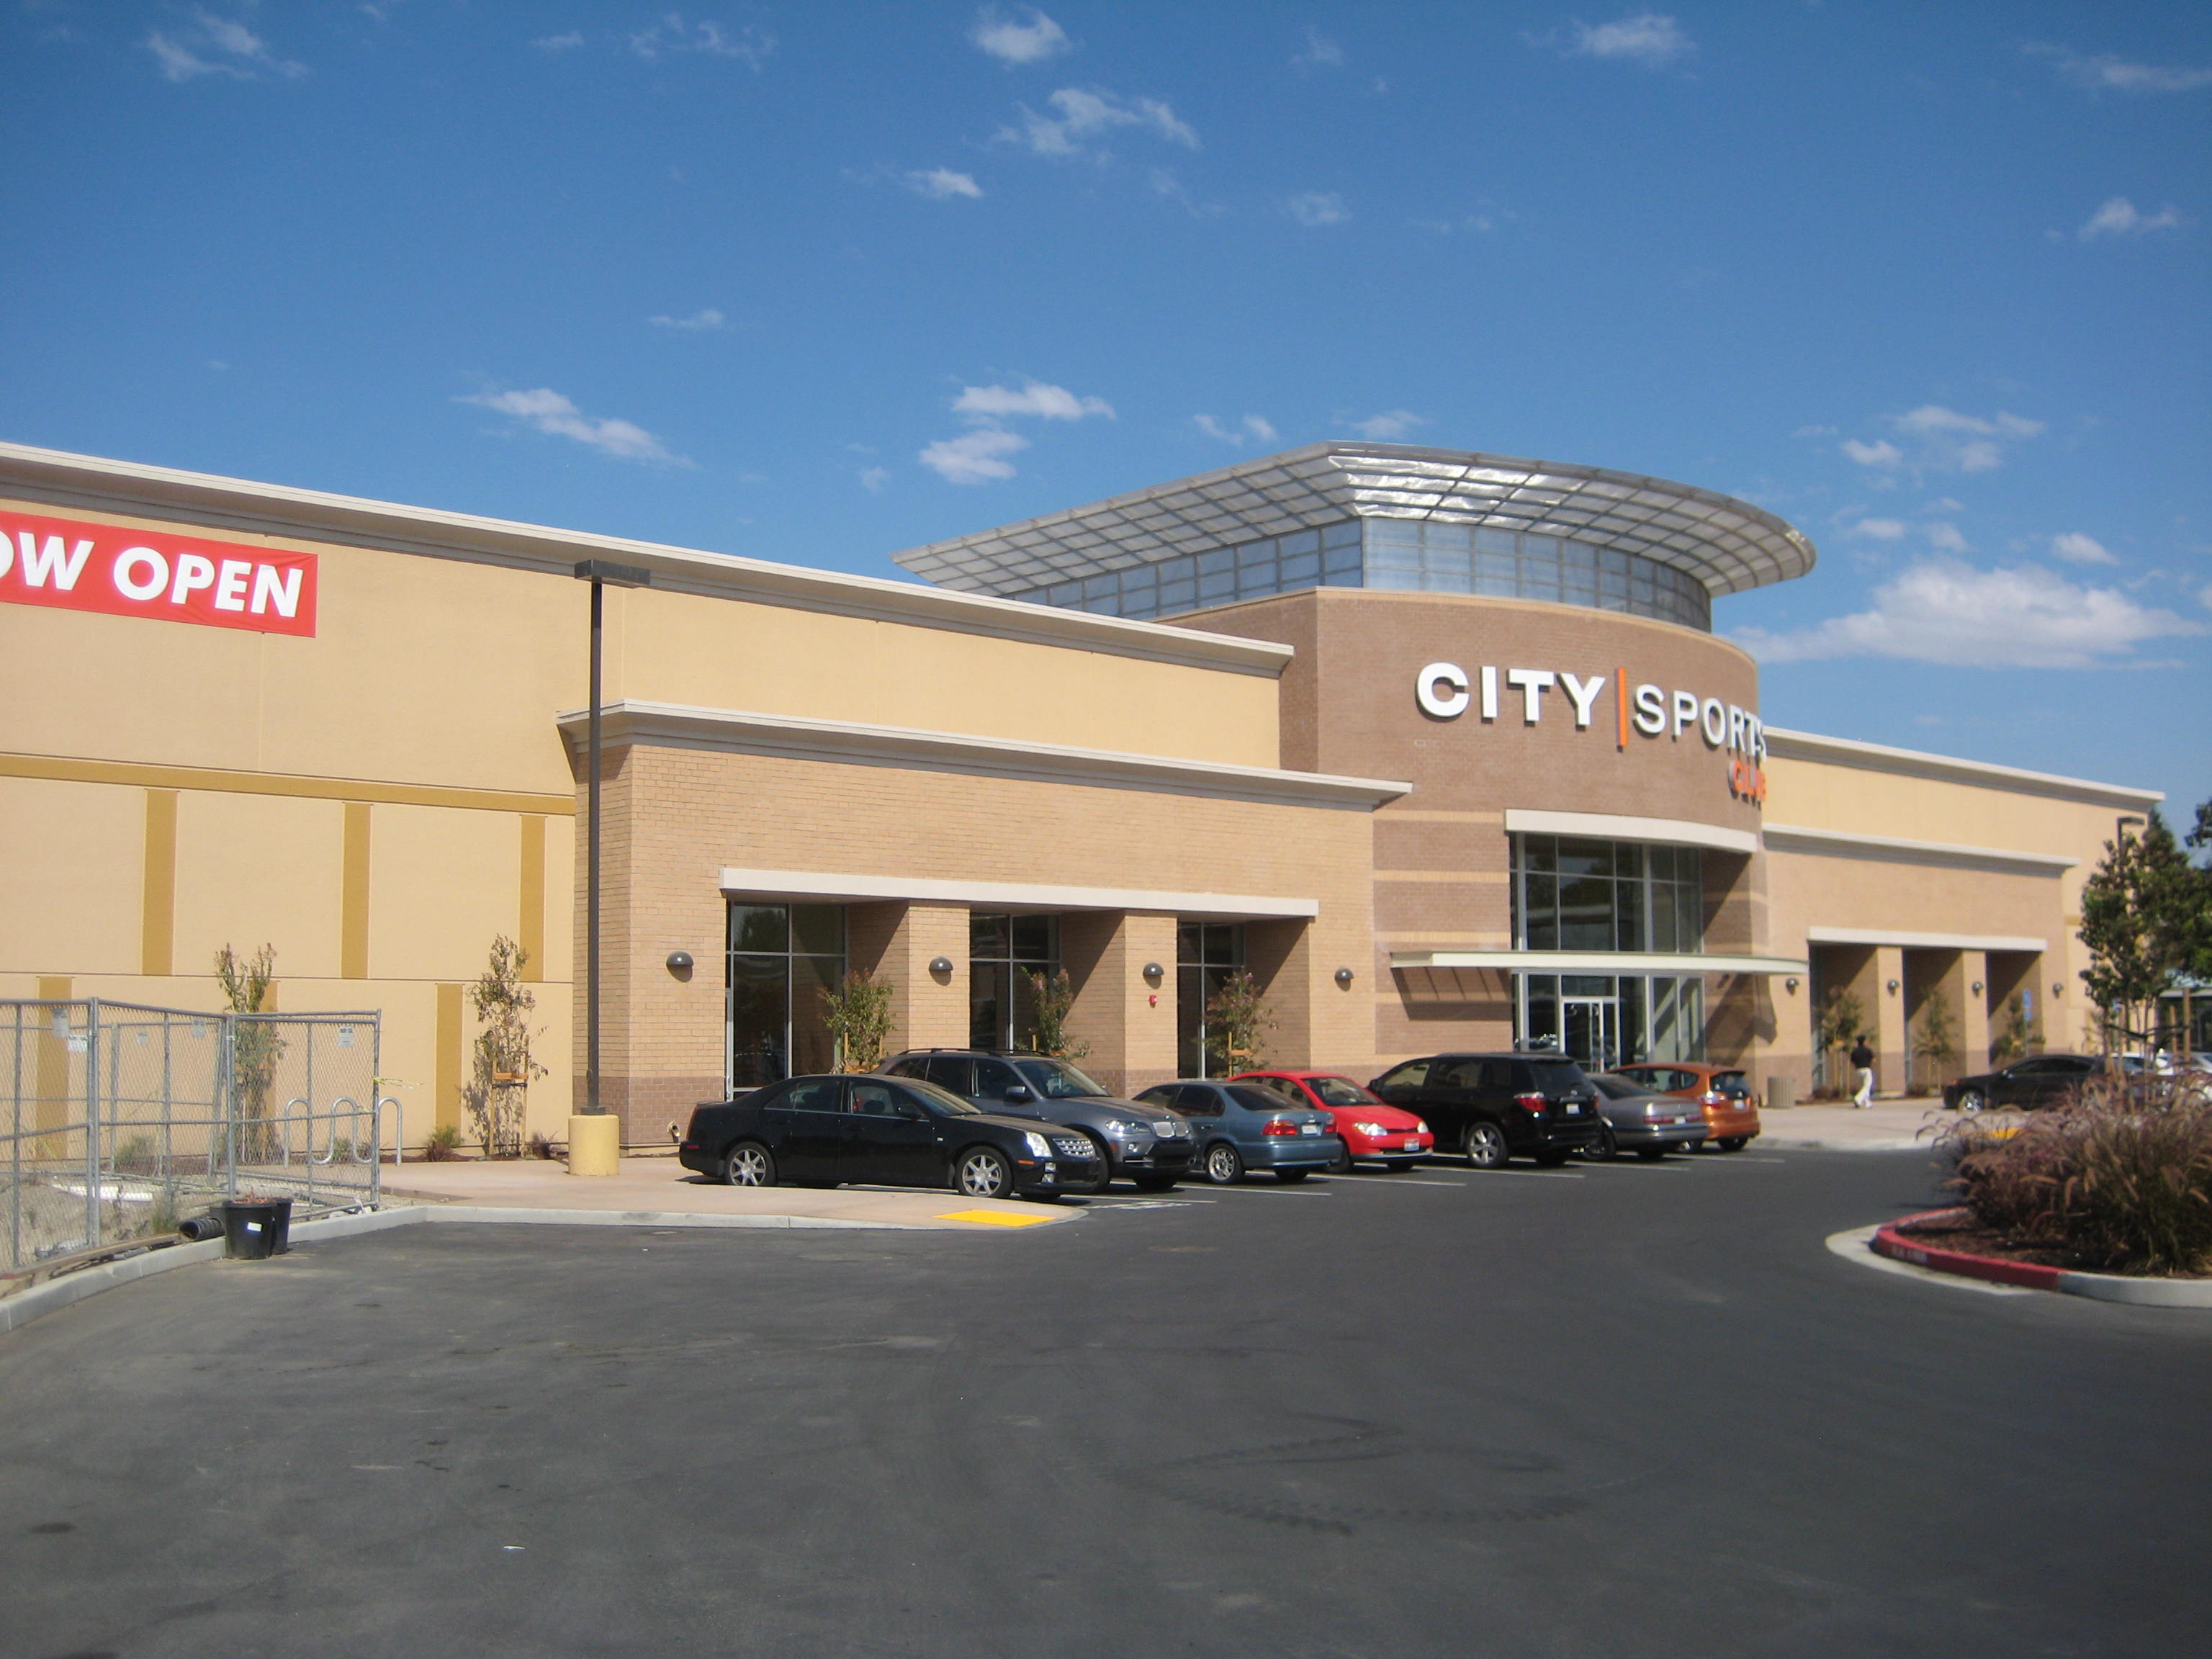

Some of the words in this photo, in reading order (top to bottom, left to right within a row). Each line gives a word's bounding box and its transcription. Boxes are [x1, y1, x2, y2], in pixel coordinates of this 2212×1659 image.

[0, 531, 94, 590] W
[113, 547, 303, 618] OPEN
[1415, 662, 1606, 726] CITY
[1632, 683, 1768, 762] SPORTS
